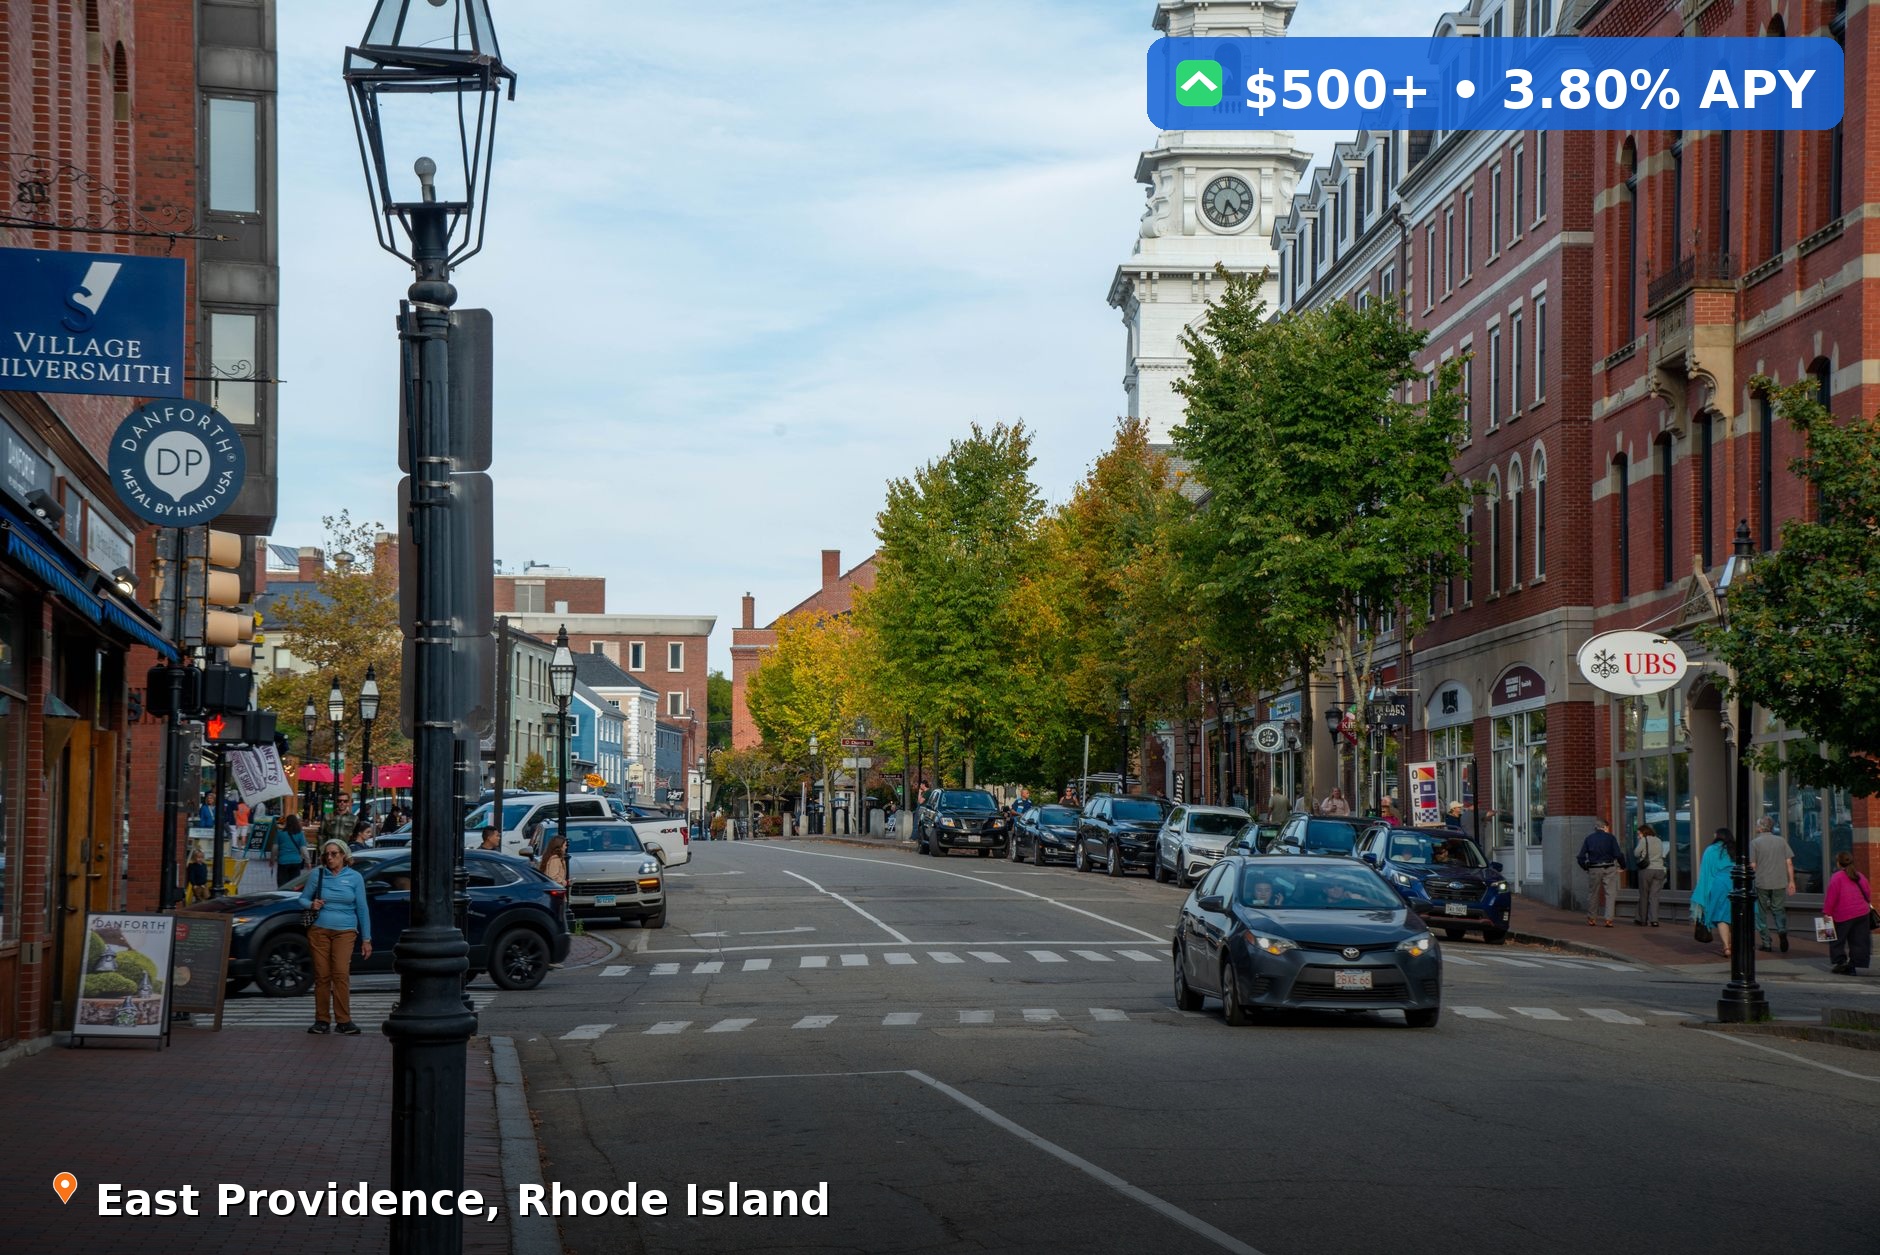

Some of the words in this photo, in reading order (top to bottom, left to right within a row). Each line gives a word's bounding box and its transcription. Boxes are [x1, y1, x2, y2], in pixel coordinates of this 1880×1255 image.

[14, 332, 141, 358] VILLAGE
[0, 358, 171, 384] ILVERSMITH
[157, 448, 202, 476] DP
[121, 468, 151, 508] METAL
[155, 503, 174, 516] BY
[177, 495, 217, 517] HAND
[214, 470, 234, 495] USA
[1624, 652, 1677, 674] UBS
[1411, 769, 1422, 822] OPEN
[95, 919, 166, 930] DANFORTH
